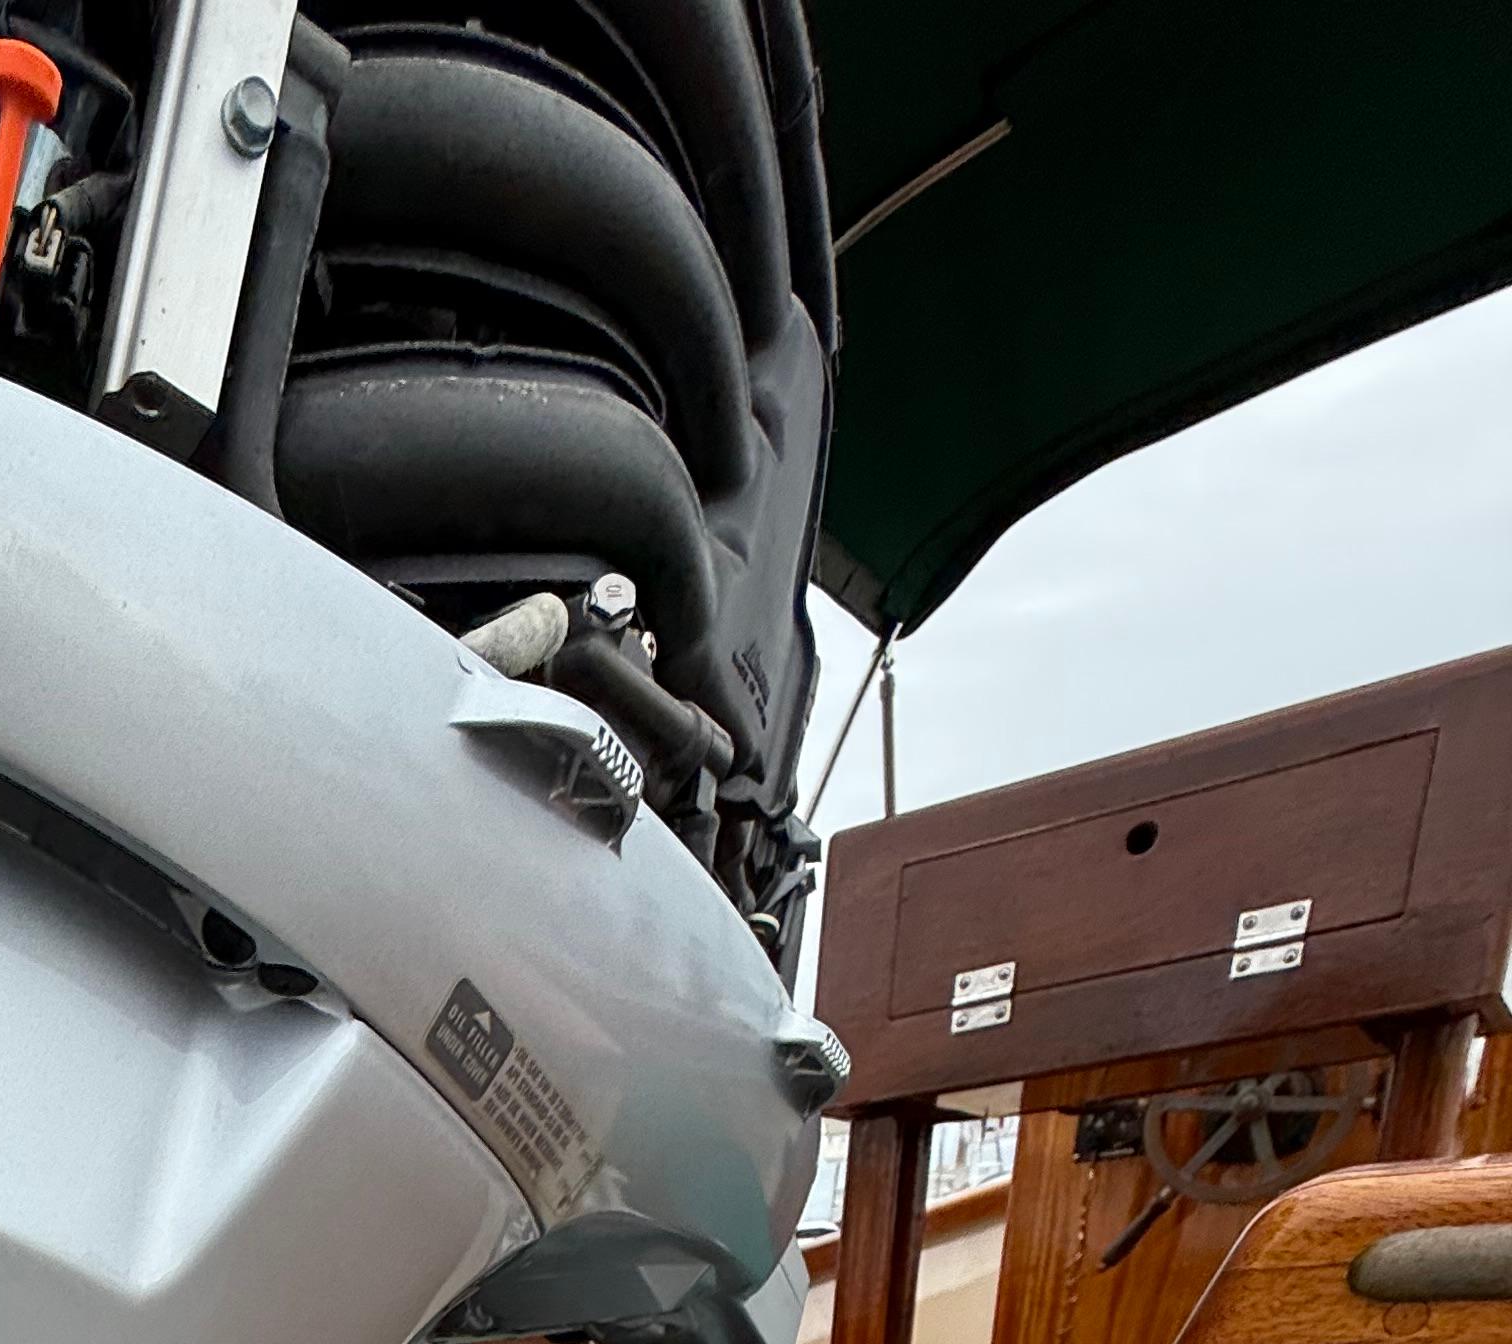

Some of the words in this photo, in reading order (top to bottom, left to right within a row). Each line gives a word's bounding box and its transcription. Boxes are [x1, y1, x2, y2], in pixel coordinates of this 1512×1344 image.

[436, 1023, 466, 1060] UNDER
[461, 1053, 489, 1088] COVER
[448, 1003, 467, 1032] OIL
[467, 1026, 500, 1070] FILLER
